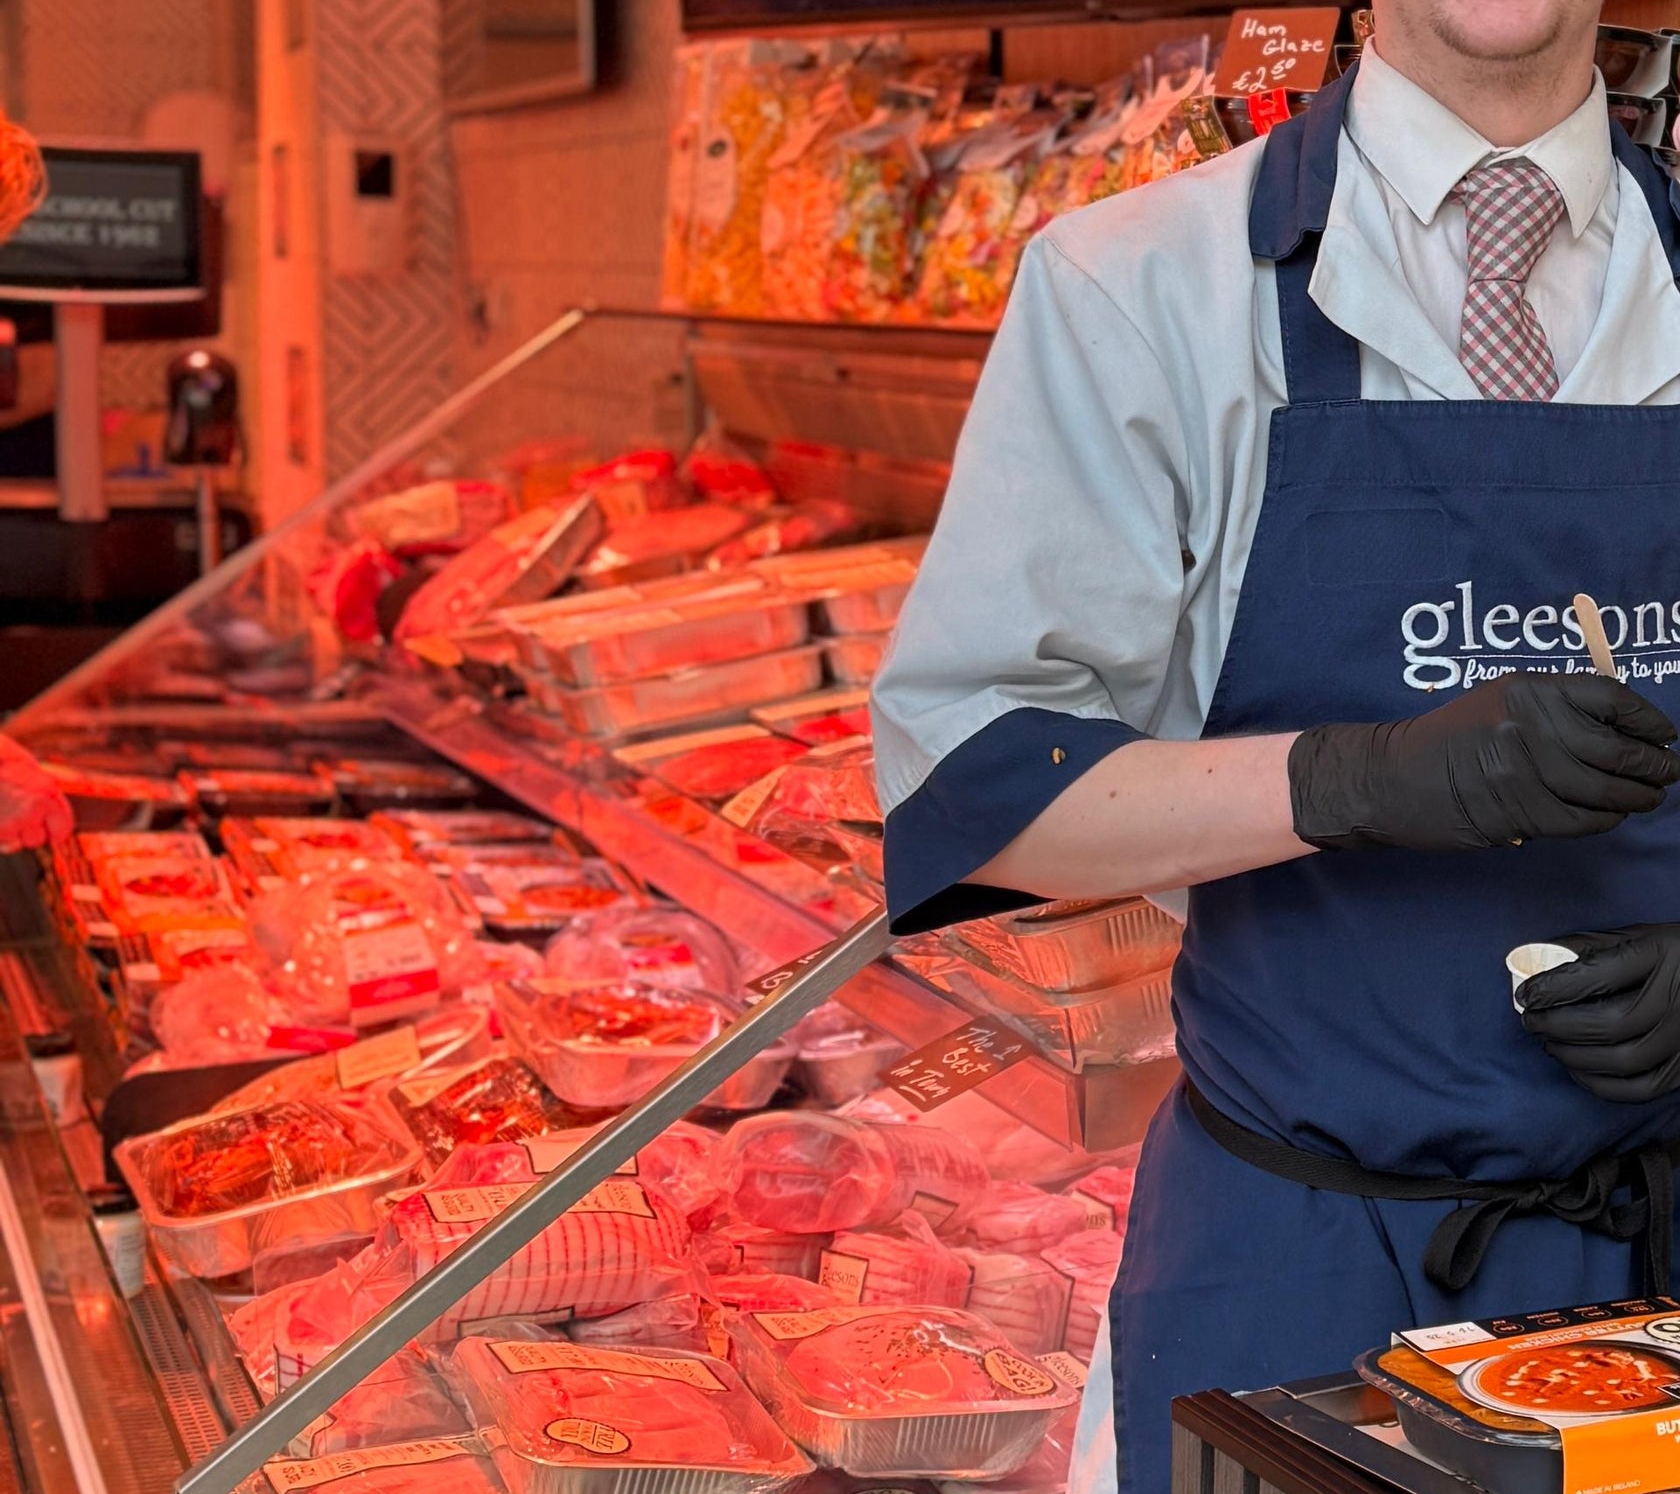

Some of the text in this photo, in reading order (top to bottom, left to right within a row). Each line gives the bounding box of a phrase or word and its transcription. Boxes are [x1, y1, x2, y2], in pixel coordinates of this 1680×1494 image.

[1240, 18, 1287, 39] Ham
[1262, 38, 1326, 56] Glaze
[1632, 657, 1652, 679] to
[956, 1027, 994, 1053] The
[890, 1059, 912, 1078] in
[943, 1048, 993, 1076] Best
